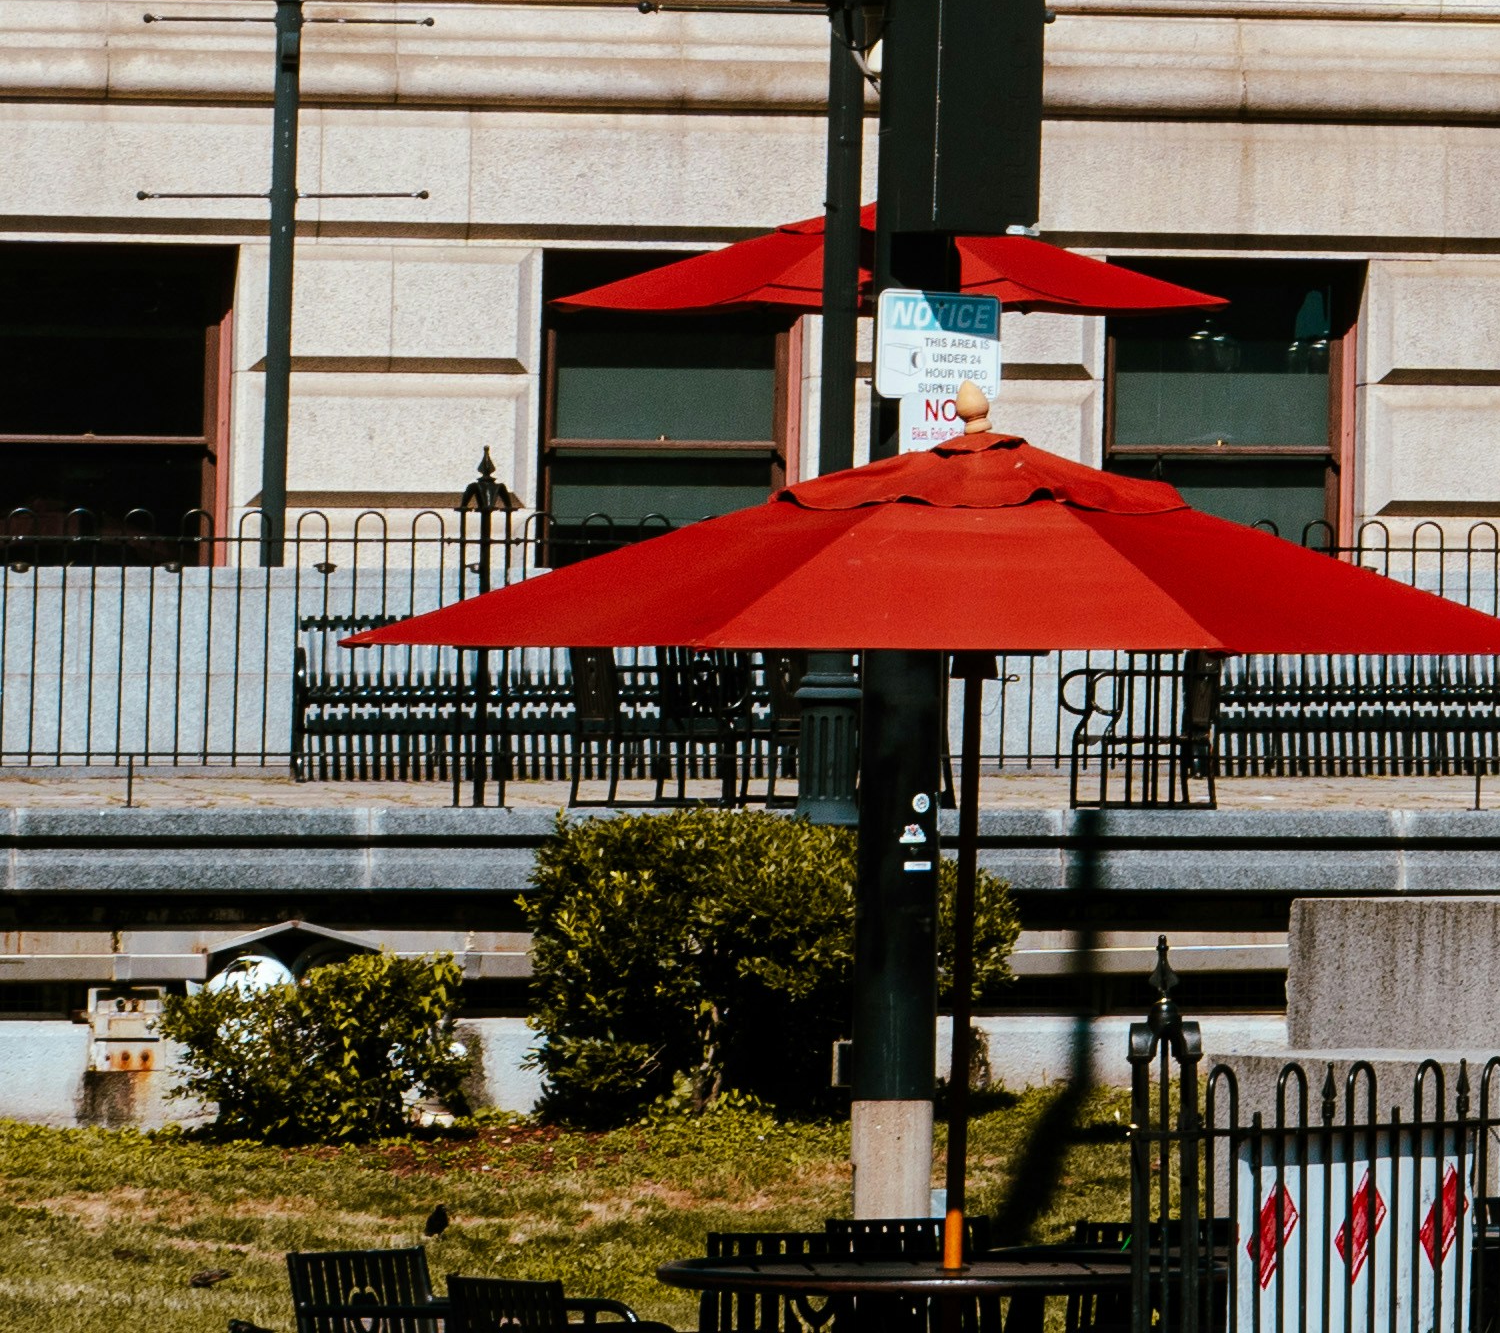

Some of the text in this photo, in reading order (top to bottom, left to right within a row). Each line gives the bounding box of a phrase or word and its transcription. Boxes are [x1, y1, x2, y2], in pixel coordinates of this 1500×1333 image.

[893, 301, 991, 329] NOTICE
[925, 337, 990, 350] THIS AREA IS
[932, 353, 982, 364] UNDER 24
[925, 368, 988, 380] HOUR VIDEO
[925, 399, 957, 422] NO
